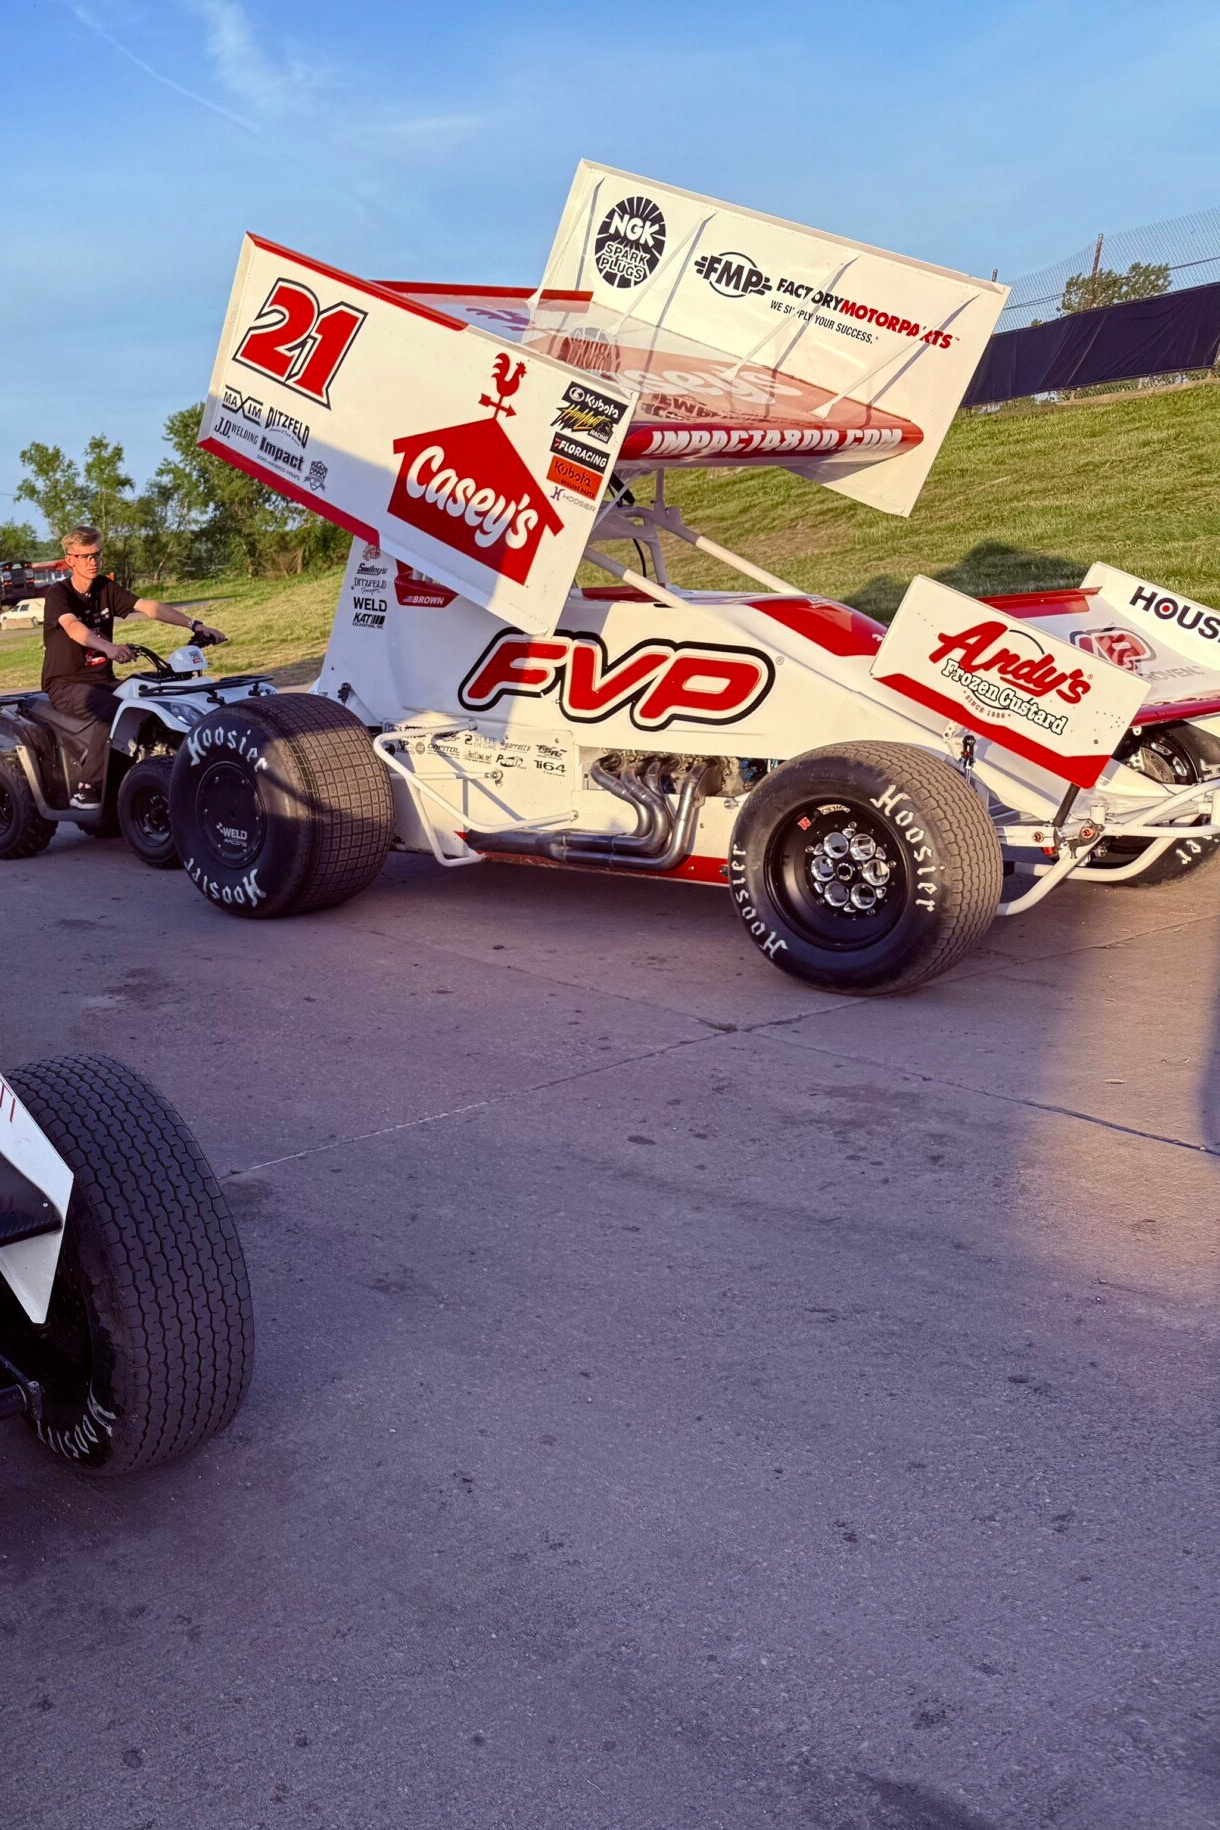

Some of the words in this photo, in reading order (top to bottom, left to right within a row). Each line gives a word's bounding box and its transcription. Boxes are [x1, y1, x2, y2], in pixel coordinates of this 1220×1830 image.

[609, 213, 660, 249] NGK
[597, 256, 645, 283] PLUGS
[604, 241, 649, 267] SPARK
[701, 256, 765, 296] FMP
[770, 300, 783, 312] WE
[814, 313, 836, 331] YOUR
[835, 322, 873, 344] SUCCESS.
[232, 277, 368, 411] 21
[584, 392, 619, 419] Kubota
[230, 422, 259, 445] WELDING
[265, 406, 310, 450] DITZFELD
[259, 436, 305, 473] Impact
[558, 440, 608, 468] FLORACING
[554, 460, 592, 488] Kubota
[406, 445, 538, 549] Casey's
[562, 493, 596, 512] HOOSIER
[353, 597, 388, 613] WELD
[412, 595, 445, 606] BROWN
[1129, 586, 1220, 643] HOUS
[461, 629, 775, 730] FVP
[928, 621, 1091, 705] Andy's
[941, 657, 1001, 703] Frozen
[998, 687, 1069, 736] Custard
[222, 826, 248, 840] WELD
[870, 784, 945, 912] Hoosier
